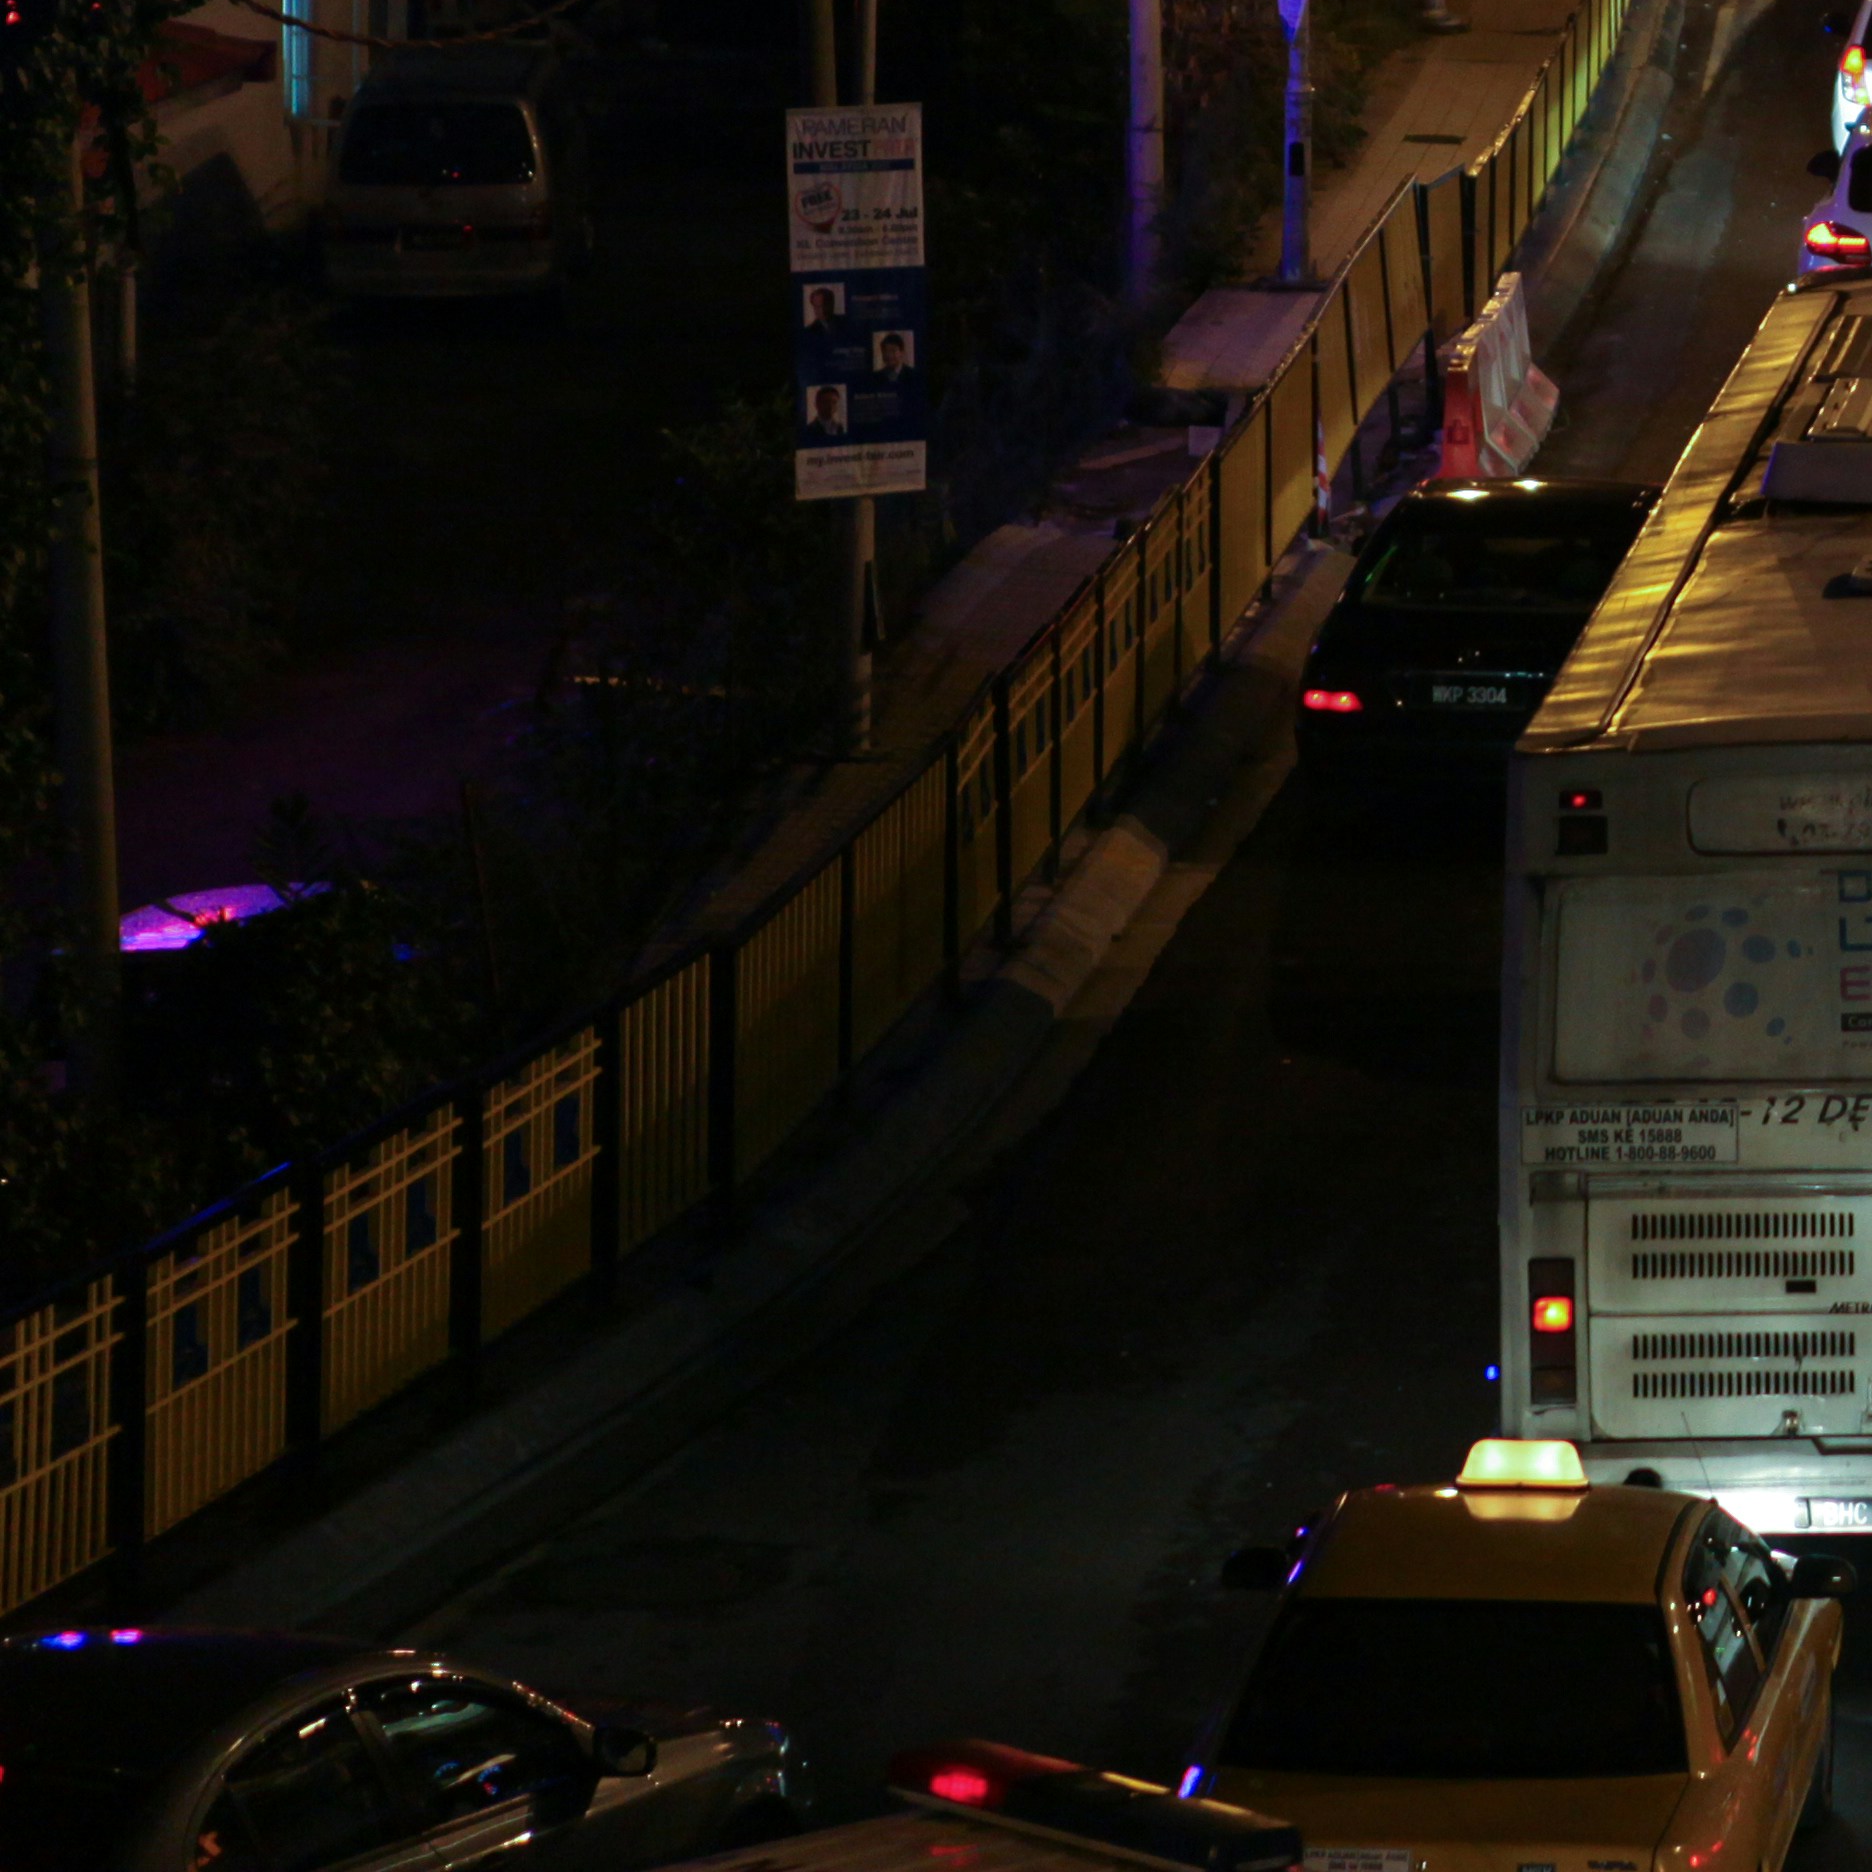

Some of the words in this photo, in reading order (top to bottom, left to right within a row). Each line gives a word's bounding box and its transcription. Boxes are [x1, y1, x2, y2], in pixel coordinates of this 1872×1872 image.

[792, 139, 871, 159] INVEST
[1525, 1110, 1565, 1126] LPKP
[1569, 1109, 1621, 1124] ADUAN
[1761, 1094, 1806, 1125] 12
[1578, 1129, 1609, 1144] SMS
[1614, 1129, 1633, 1143] KE
[1639, 1129, 1682, 1143] 15888
[1545, 1146, 1610, 1161] HOTLINE
[1616, 1146, 1716, 1161] 1-800-88-9600
